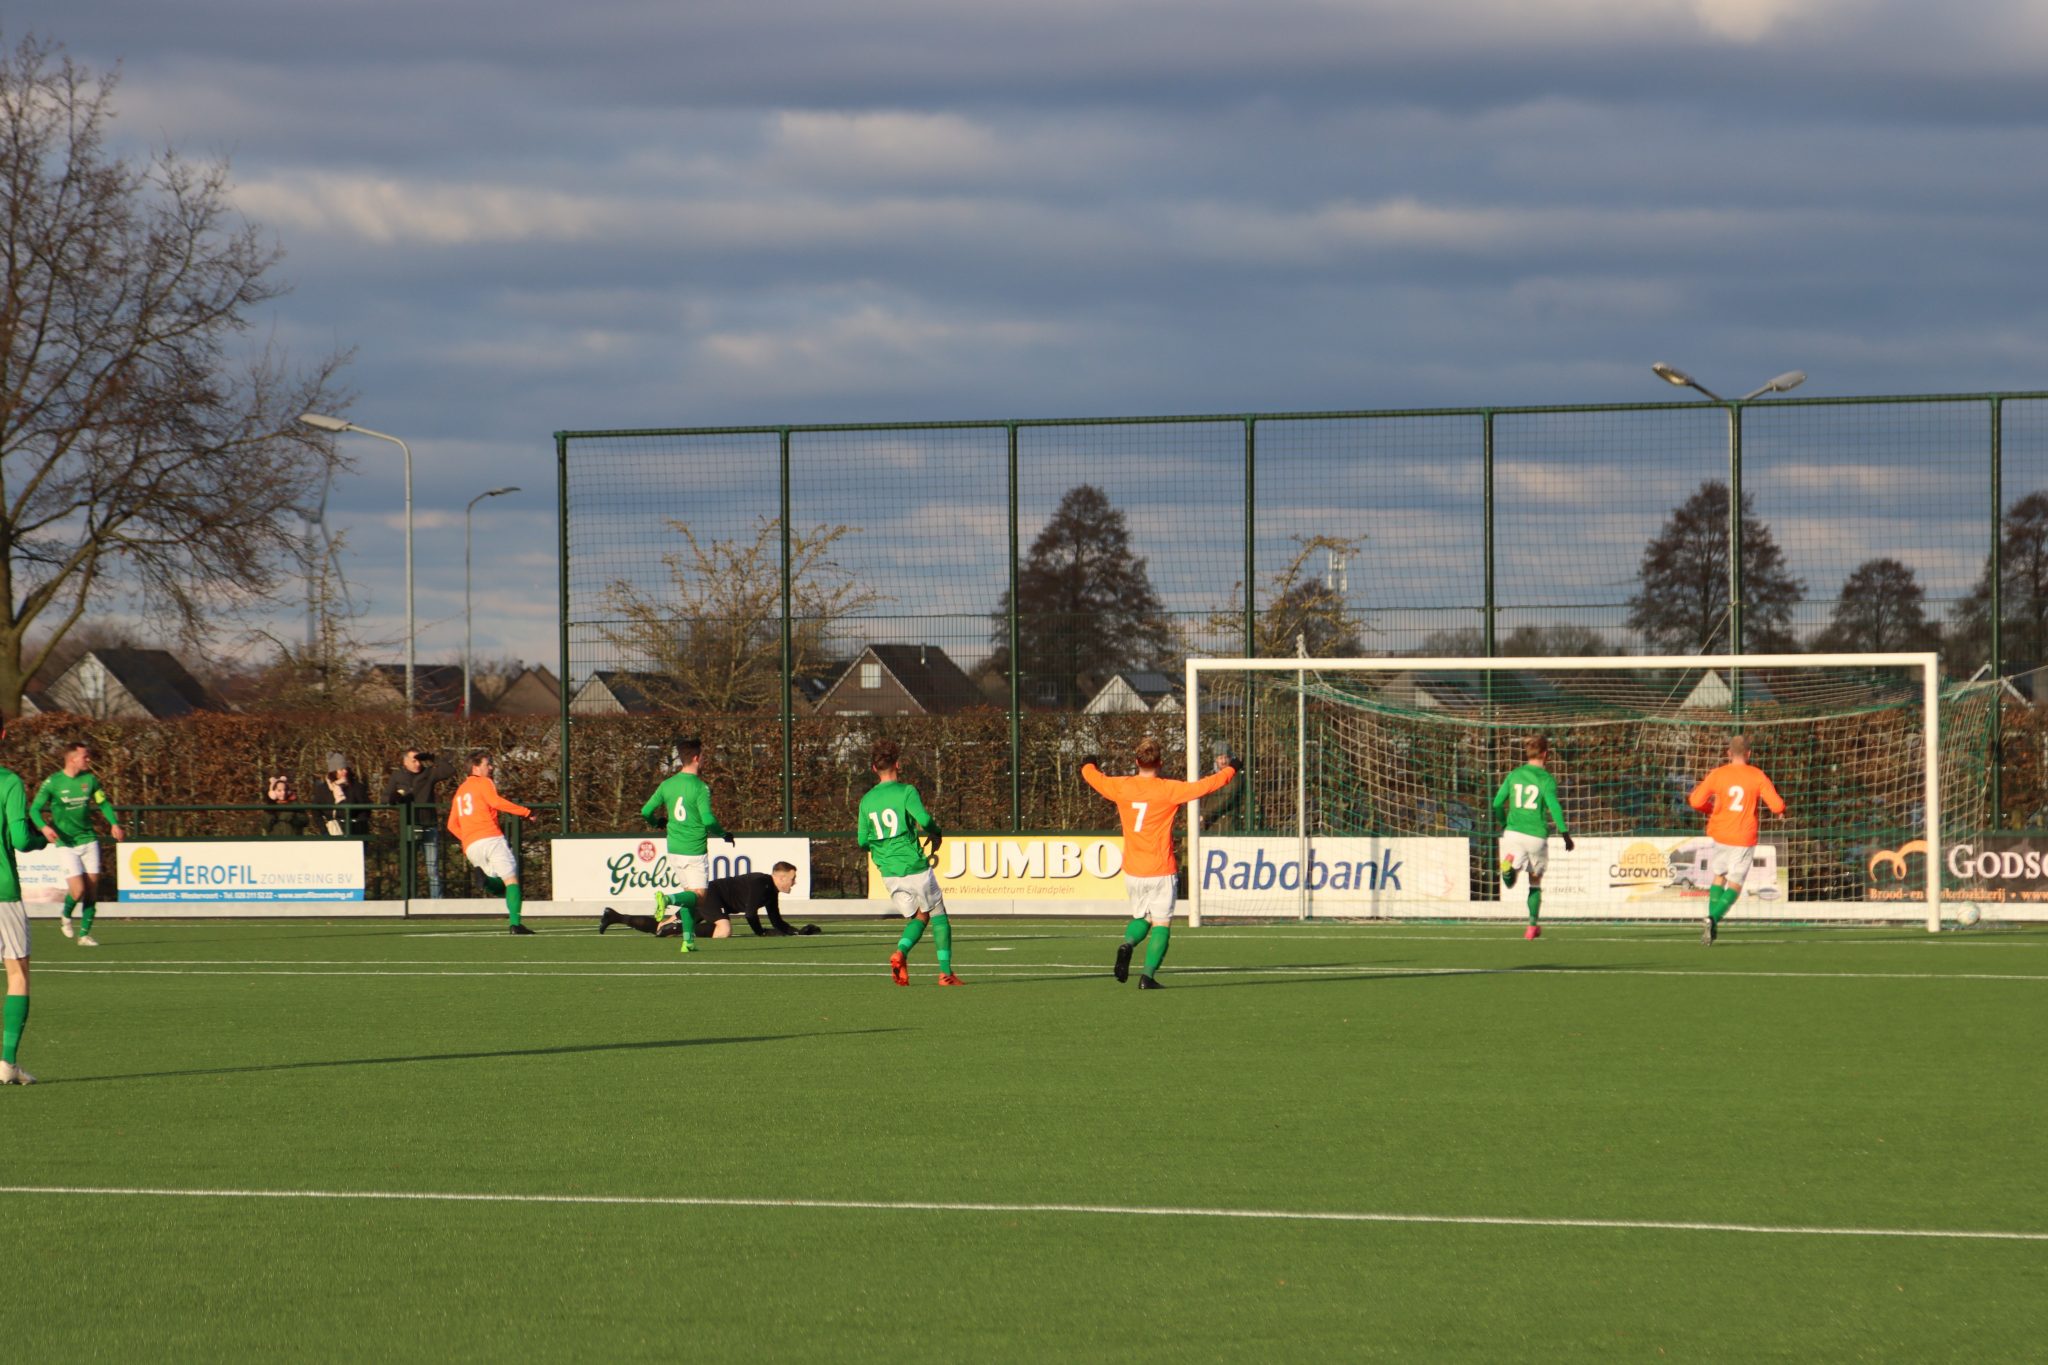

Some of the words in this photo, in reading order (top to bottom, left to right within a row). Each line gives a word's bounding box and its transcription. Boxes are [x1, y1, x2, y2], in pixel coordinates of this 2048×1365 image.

[456, 793, 473, 816] 13
[674, 796, 686, 821] 6
[1514, 784, 1539, 809] 12
[1728, 785, 1744, 812] 2
[868, 808, 898, 840] 19
[1131, 802, 1147, 832] 7
[140, 856, 257, 885] AEROFIL
[260, 873, 333, 885] ZONWERING
[337, 873, 353, 884] BV
[943, 840, 1122, 879] JUMBO
[1203, 849, 1403, 891] Rabobank
[1609, 864, 1676, 878] Caravans
[960, 884, 1025, 895] Winkelcentrum
